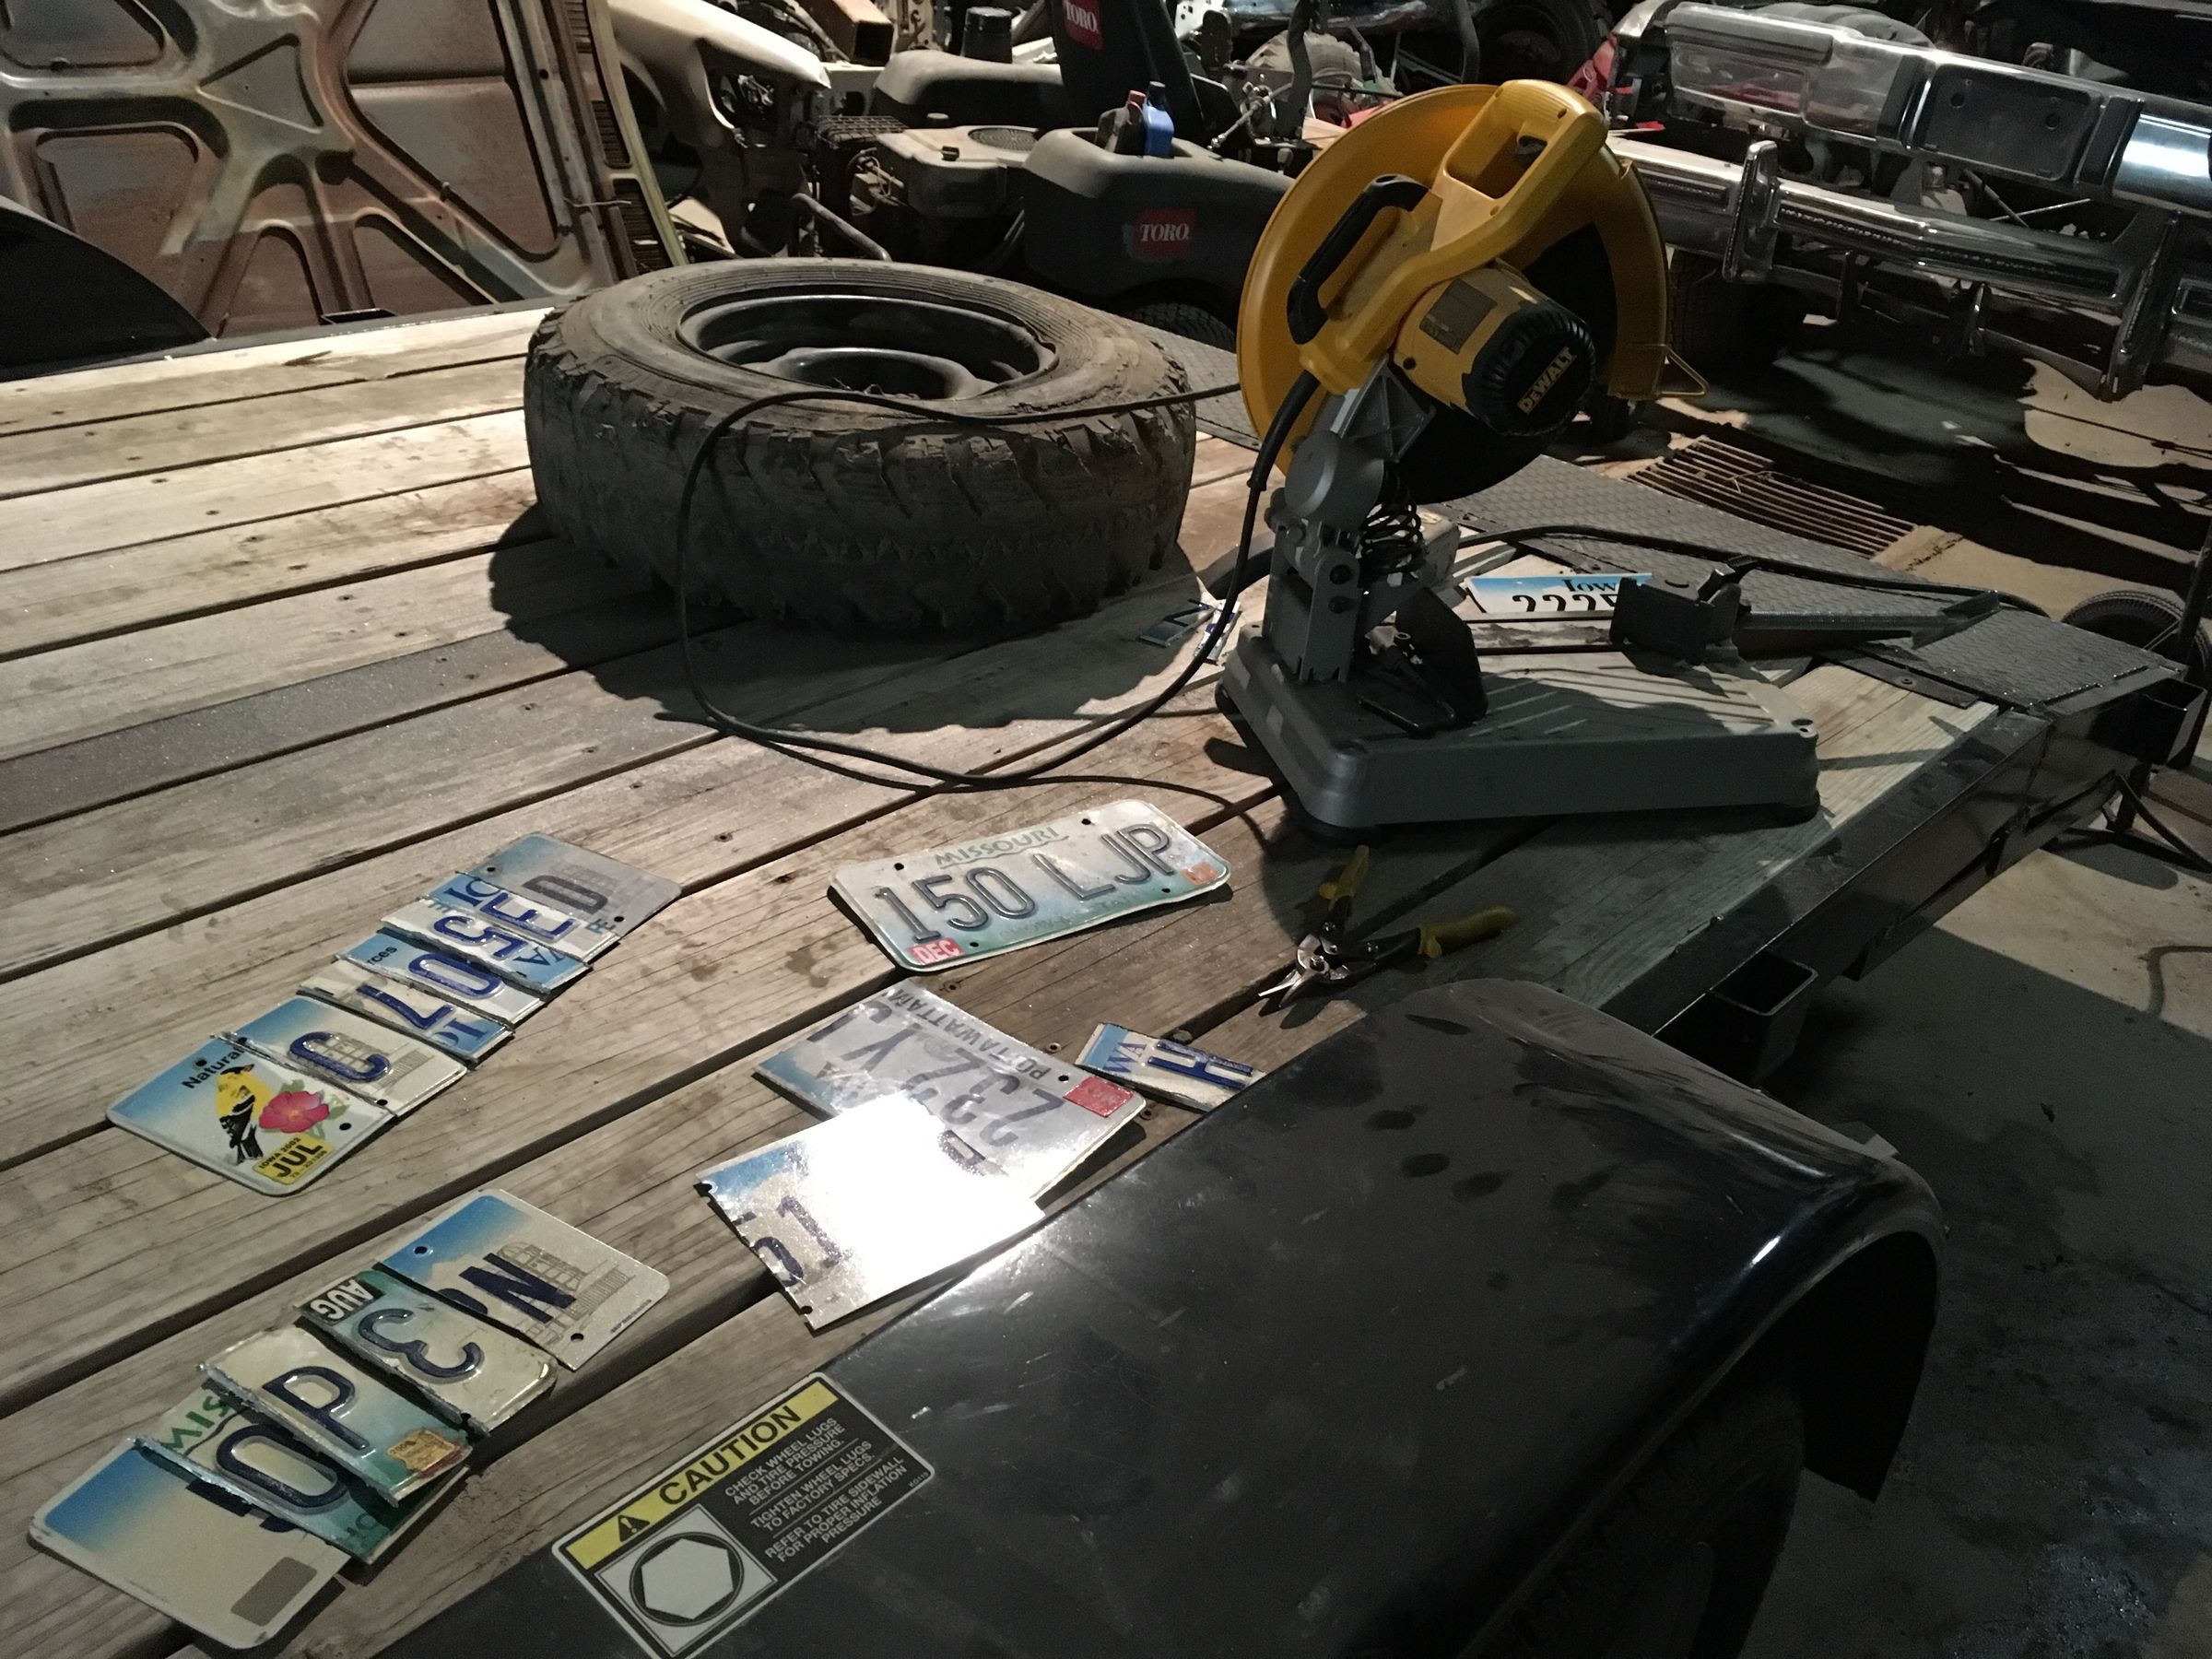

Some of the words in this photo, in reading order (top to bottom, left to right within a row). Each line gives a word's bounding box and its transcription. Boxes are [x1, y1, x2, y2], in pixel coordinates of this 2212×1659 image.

[1064, 0, 1098, 32] TORO
[1140, 223, 1189, 241] TORO
[1562, 579, 1619, 592] Iow
[935, 826, 1059, 866] MISSOURI
[875, 866, 1035, 942] 150
[911, 940, 961, 966] DEC
[273, 1145, 323, 1178] JUL
[310, 1279, 374, 1320] AUG
[659, 1405, 802, 1505] CAUTION
[724, 1464, 767, 1499] CHECK
[765, 1437, 806, 1469] WHEEL
[805, 1415, 838, 1442] LUGS
[732, 1482, 759, 1505] AND
[759, 1463, 786, 1486] TIRE
[785, 1422, 845, 1468] PRESSURE
[748, 1469, 796, 1506] BEFORE
[795, 1434, 844, 1473] TOWING.
[750, 1488, 802, 1529] TIGHTEN
[800, 1460, 842, 1493] WHEEL
[841, 1439, 873, 1465] LUGS
[763, 1515, 782, 1533] TO
[782, 1478, 835, 1519] FACTORY
[833, 1449, 876, 1482] SPECS.
[764, 1525, 806, 1559] REFER
[803, 1512, 823, 1530] TO
[821, 1493, 850, 1516] TIRE
[846, 1453, 904, 1498] SIDEWALL
[777, 1539, 805, 1562] FOR
[803, 1505, 853, 1543] PROPER
[849, 1464, 908, 1509] INFLATION
[820, 1496, 883, 1544] PRESSURE
